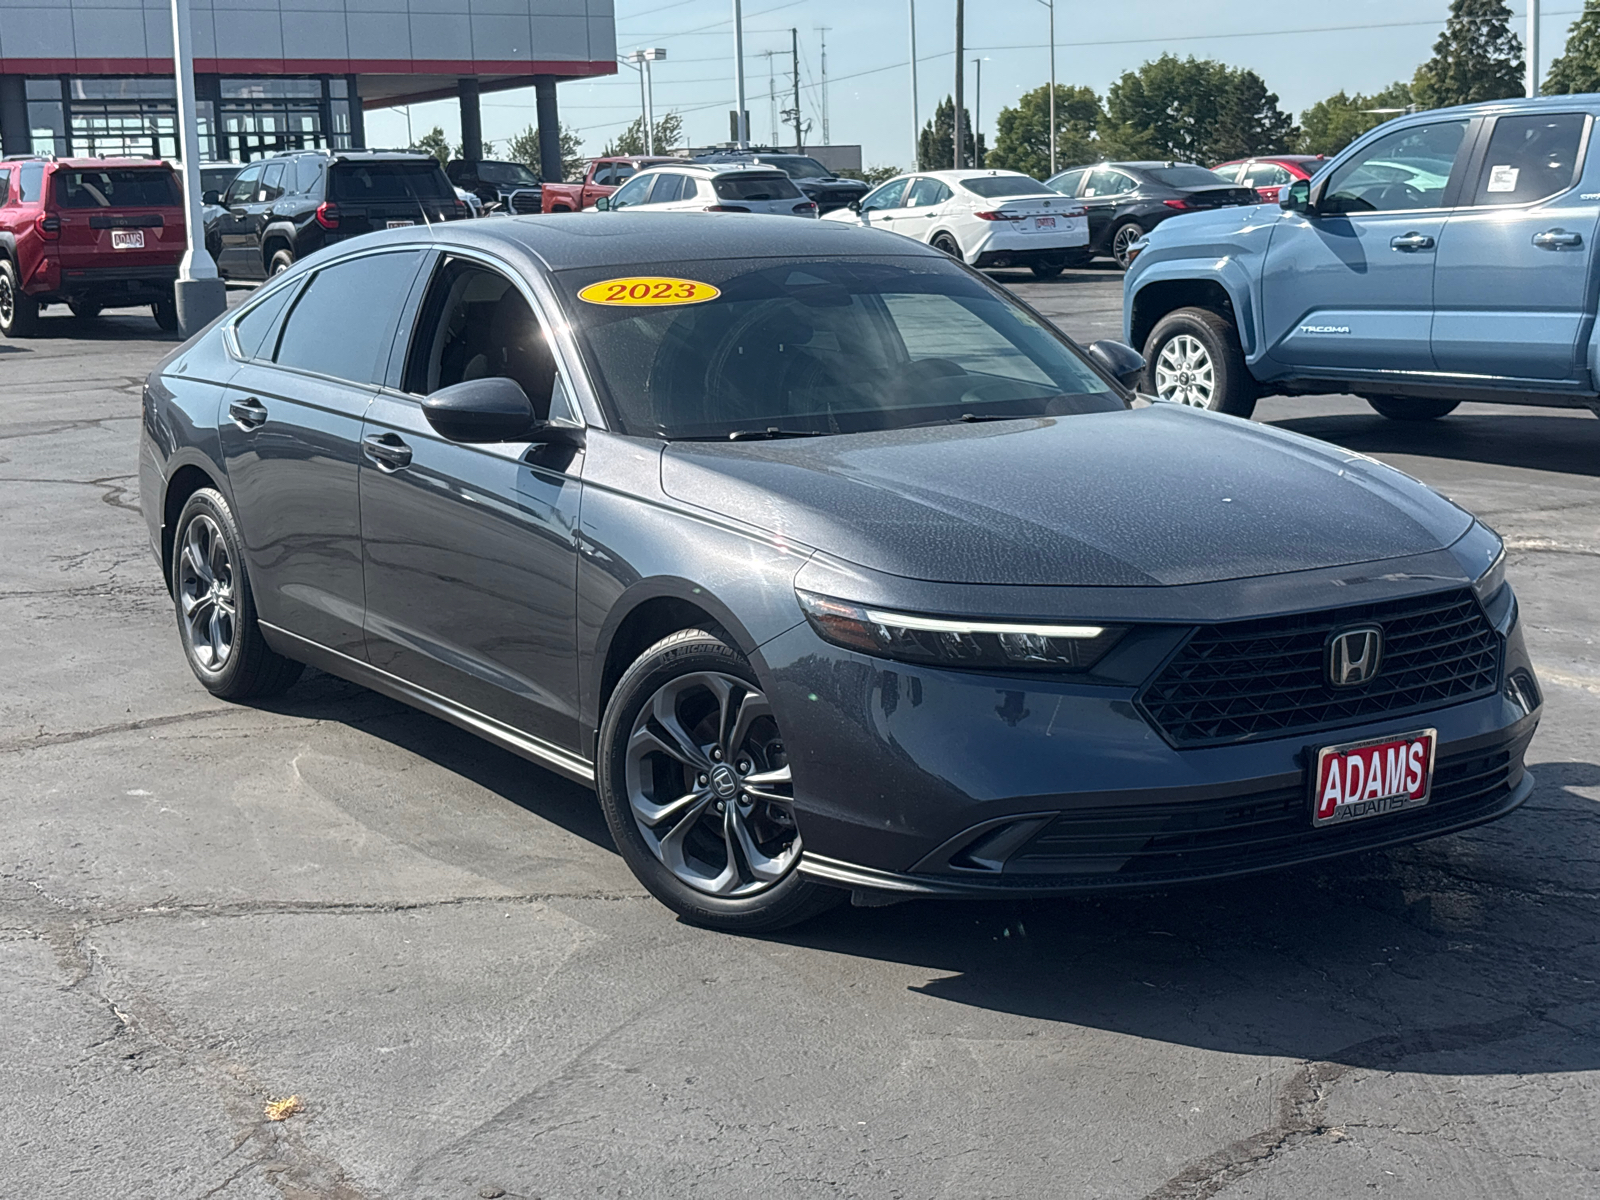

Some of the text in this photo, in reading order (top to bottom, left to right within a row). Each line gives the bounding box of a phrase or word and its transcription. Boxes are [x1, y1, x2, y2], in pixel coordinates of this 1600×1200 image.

[115, 233, 142, 245] ADAMS
[605, 283, 697, 301] 2023
[677, 644, 733, 656] MICHELIN
[1320, 742, 1423, 811] ADAMS
[1340, 795, 1404, 819] ADAMS
